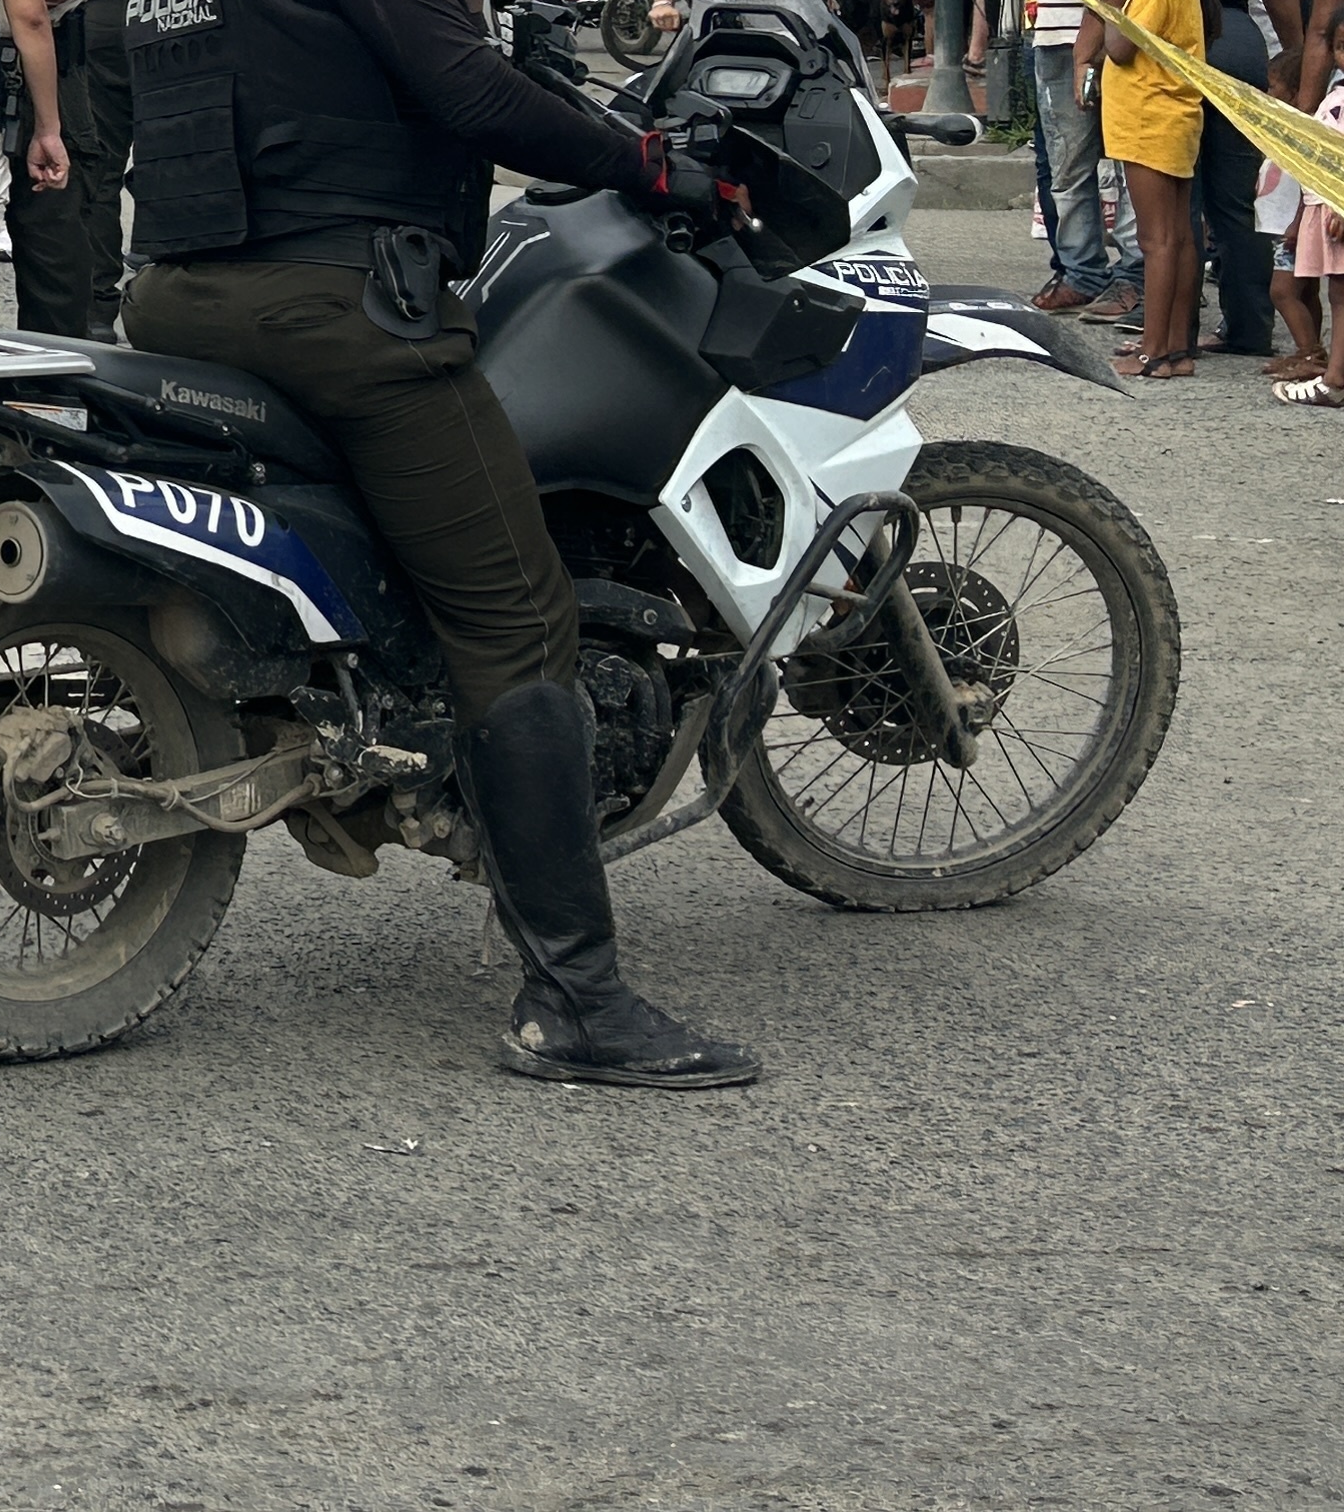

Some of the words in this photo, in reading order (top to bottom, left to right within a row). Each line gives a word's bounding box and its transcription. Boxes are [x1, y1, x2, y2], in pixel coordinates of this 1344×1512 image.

[157, 4, 217, 33] NACIONAL
[161, 379, 266, 422] Kawasaki
[105, 470, 266, 547] P070
